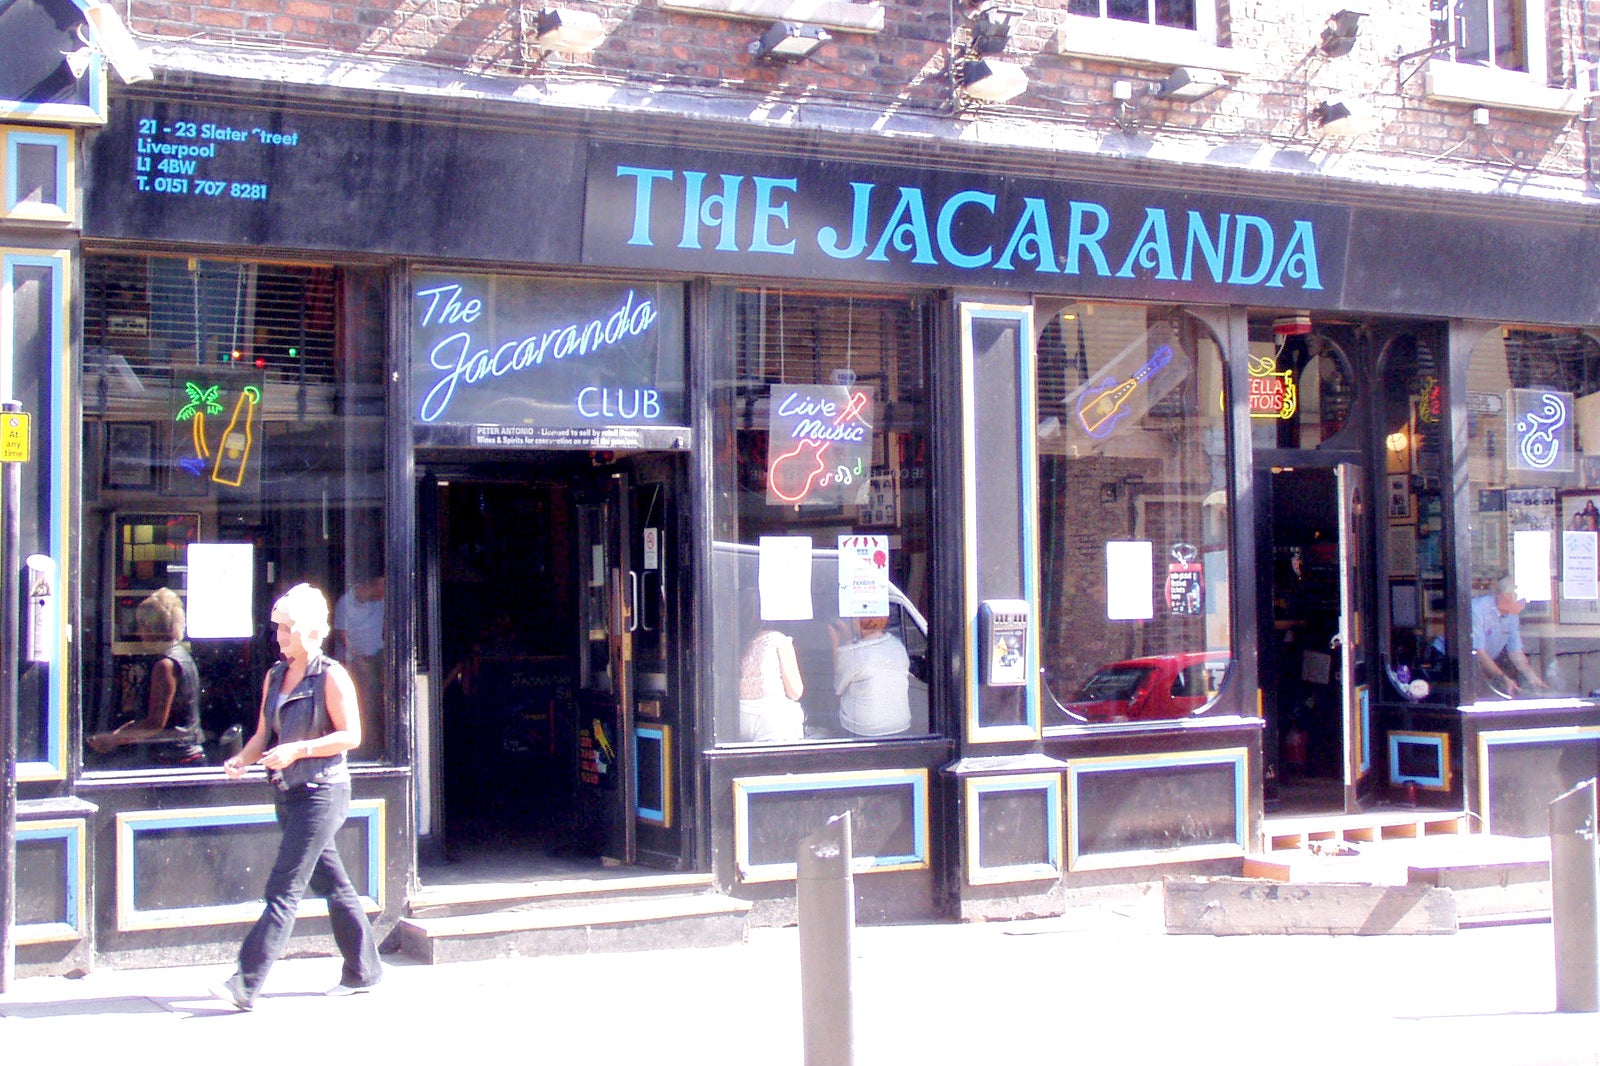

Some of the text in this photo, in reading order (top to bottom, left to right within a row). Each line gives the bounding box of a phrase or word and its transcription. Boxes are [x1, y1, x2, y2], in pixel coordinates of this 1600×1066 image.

[138, 119, 157, 134] 21
[174, 121, 197, 138] 23
[200, 123, 249, 142] Slater
[137, 138, 215, 159] Liverpool
[137, 156, 196, 175] L1 4BW
[136, 175, 268, 200] T. 0151 707 8281
[616, 165, 1326, 290] THE JACARANDA
[416, 284, 483, 328] The
[420, 289, 658, 423] Jacaranda
[1248, 378, 1284, 394] ELLA
[576, 386, 662, 419] CLUB
[778, 392, 836, 416] Live
[1249, 395, 1283, 410] TOIS
[477, 427, 500, 435] PETER
[501, 427, 534, 435] ANTONIO
[592, 429, 601, 438] by
[502, 436, 524, 445] Spirits
[791, 419, 864, 441] Music
